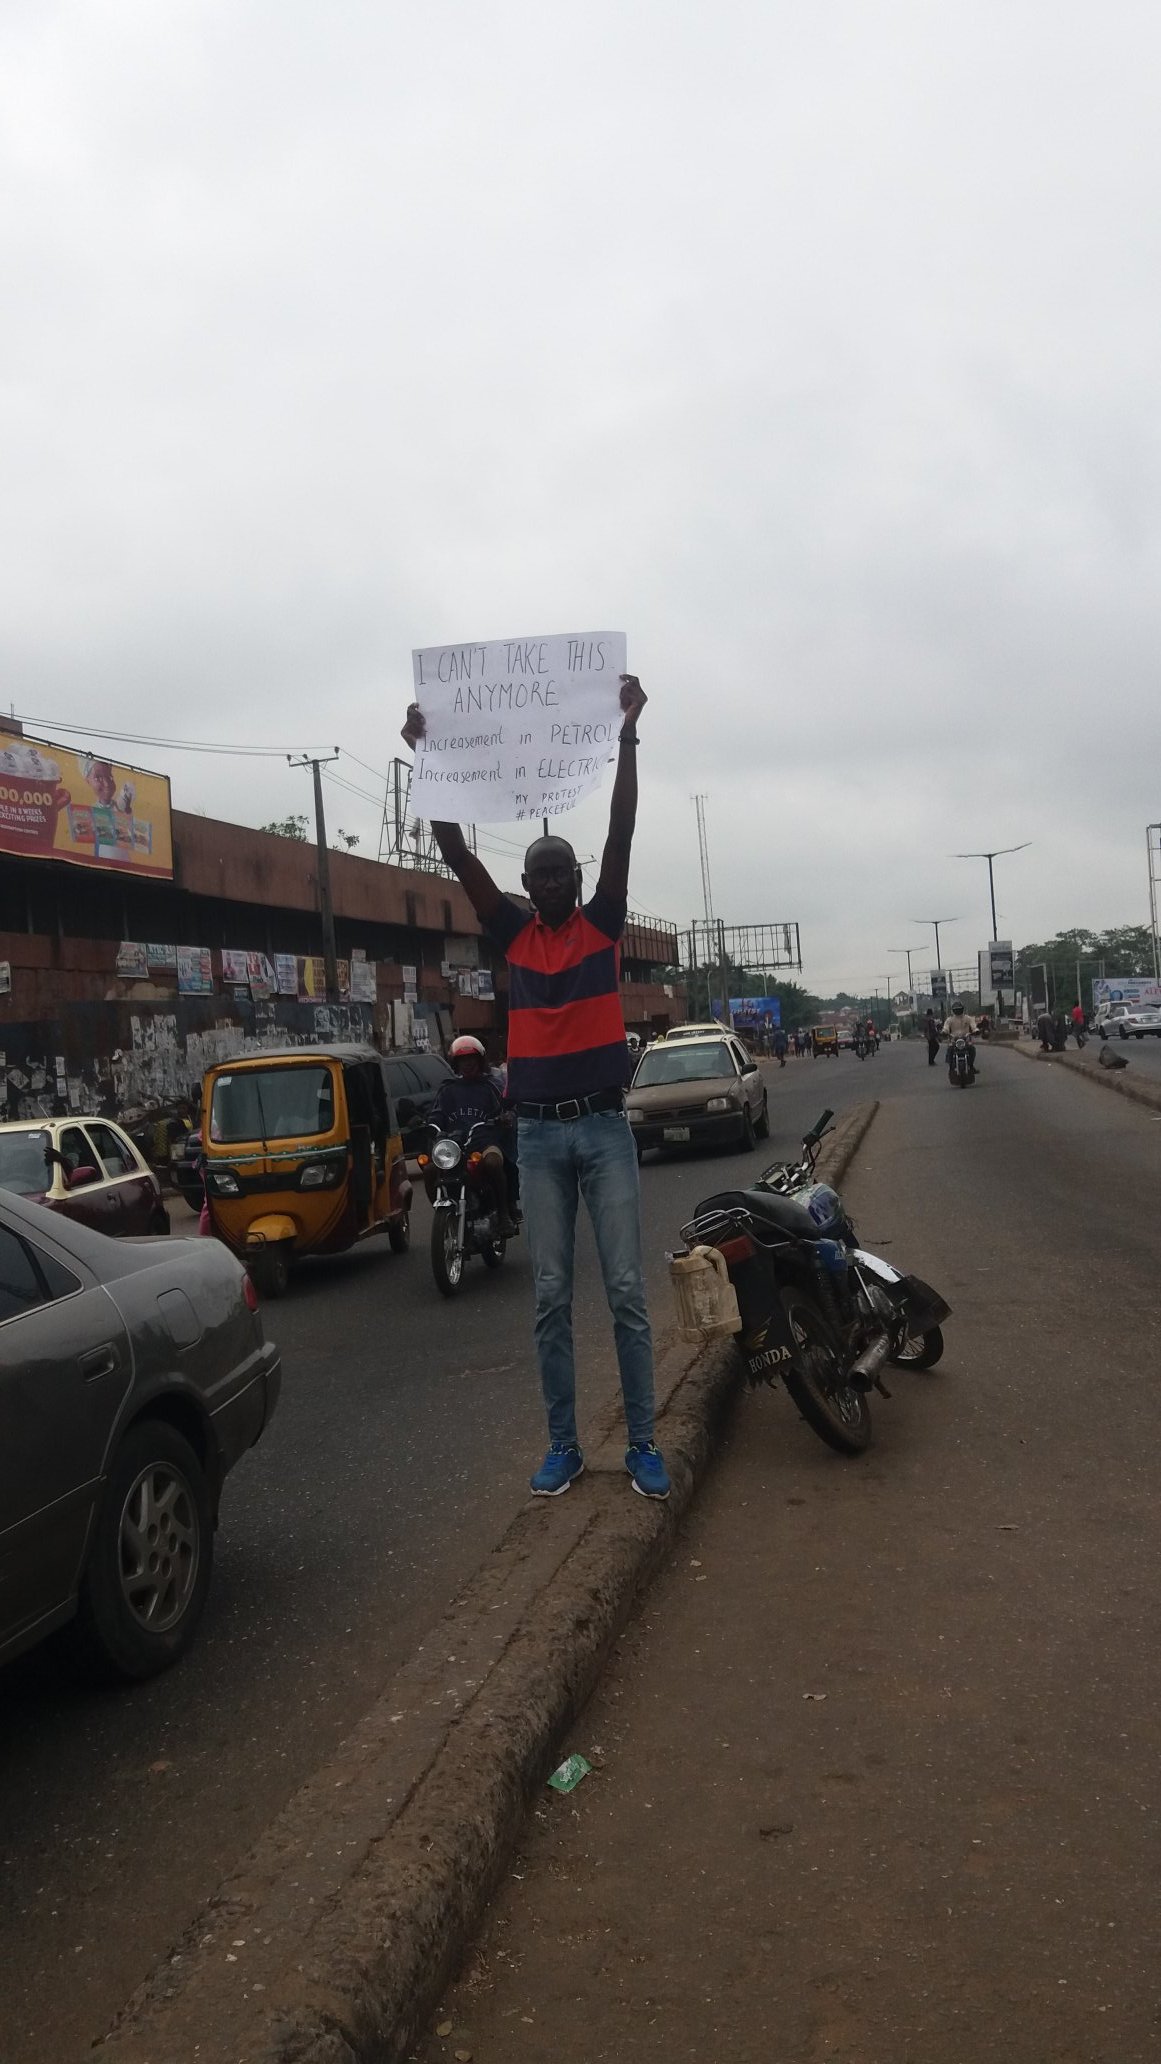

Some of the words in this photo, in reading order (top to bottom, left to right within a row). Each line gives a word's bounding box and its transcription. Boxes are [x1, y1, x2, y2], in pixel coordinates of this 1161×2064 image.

[418, 654, 427, 686] I
[437, 646, 487, 683] CAN'T
[503, 642, 549, 675] TAKE
[567, 639, 605, 672] THIS
[453, 679, 560, 713] ANYMORE
[421, 724, 504, 753] Increasement
[519, 733, 532, 745] in
[550, 723, 616, 745] PETROL
[418, 758, 502, 784] Increasement
[515, 765, 527, 779] in
[515, 793, 529, 805] MY
[541, 784, 584, 803] PROTEST
[749, 1346, 792, 1373] HONDA
